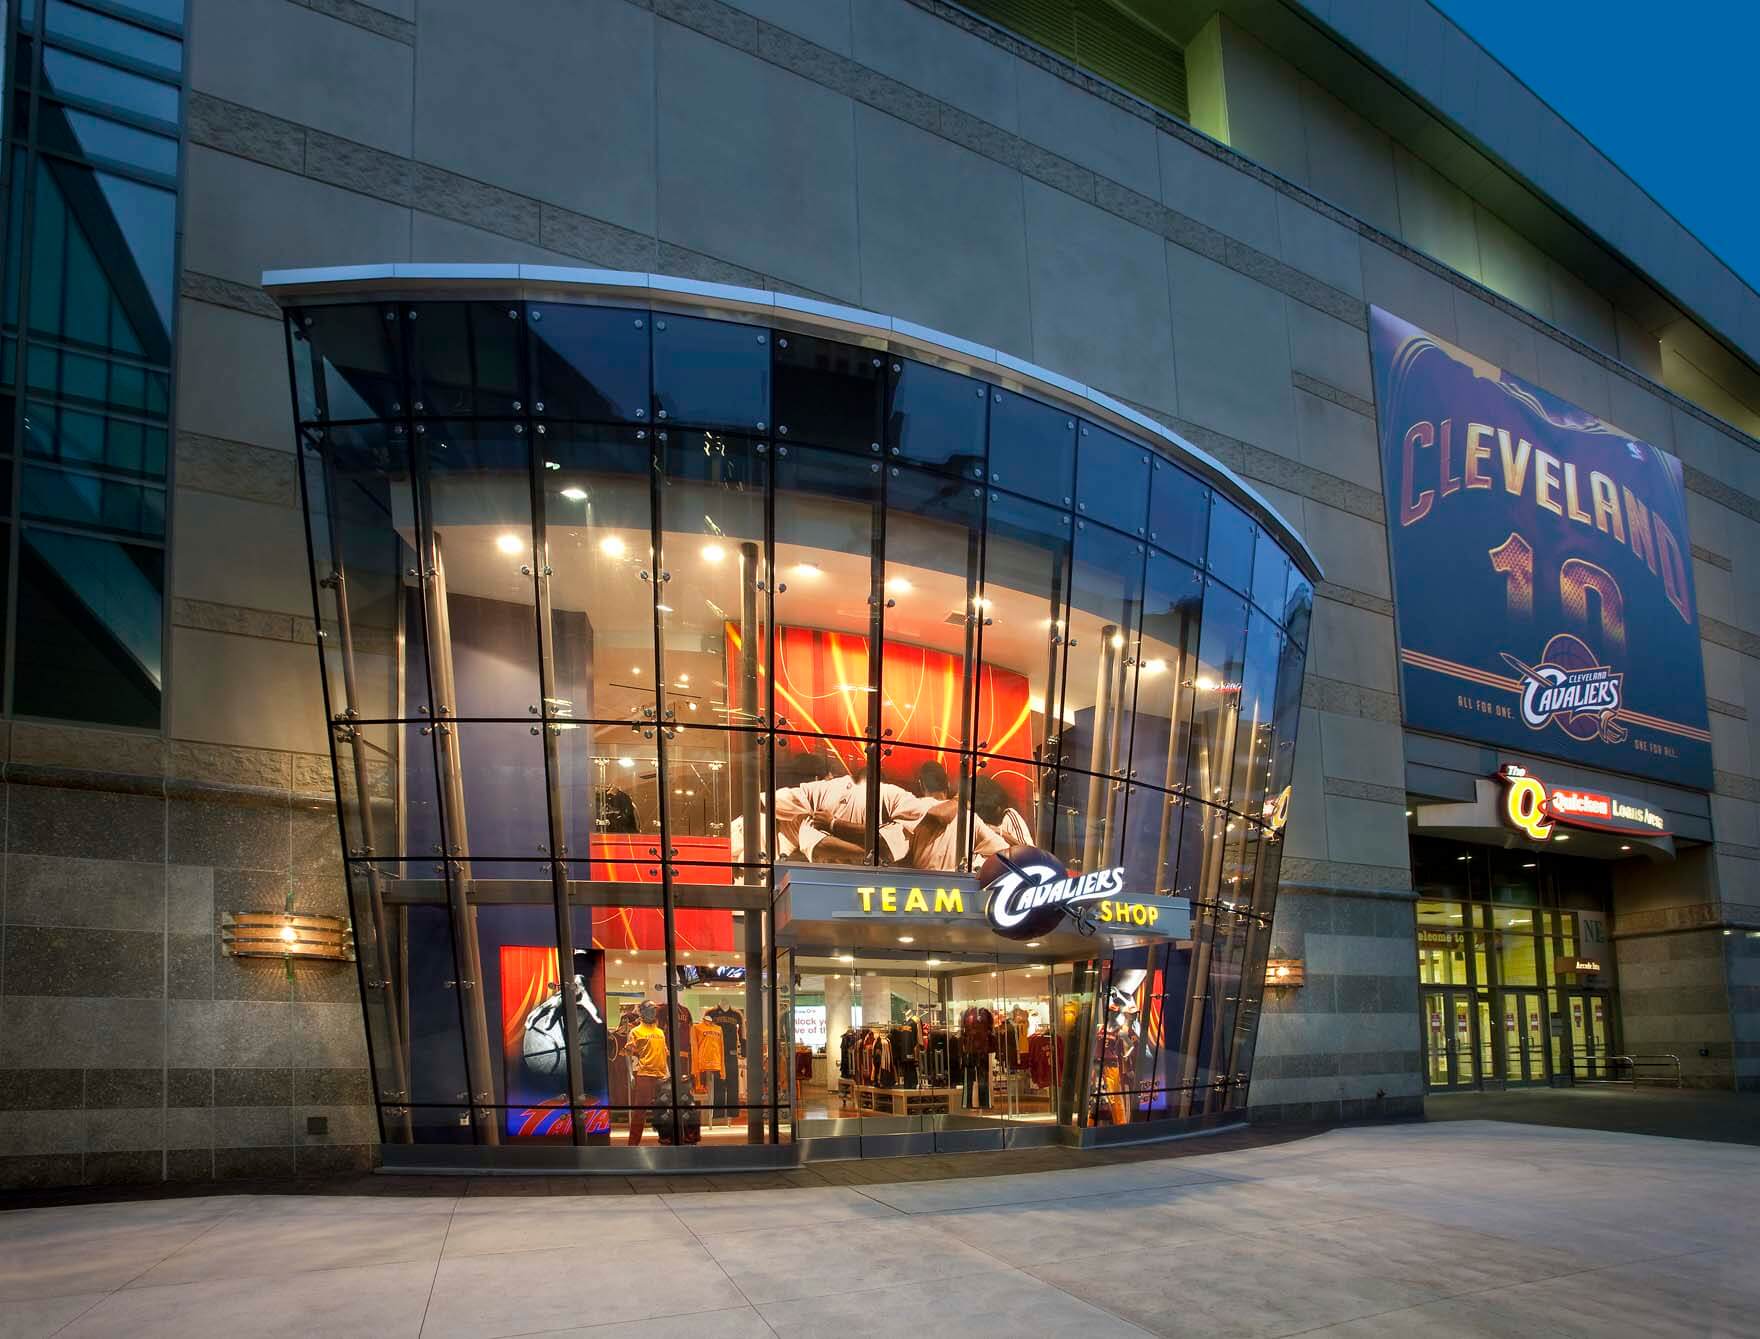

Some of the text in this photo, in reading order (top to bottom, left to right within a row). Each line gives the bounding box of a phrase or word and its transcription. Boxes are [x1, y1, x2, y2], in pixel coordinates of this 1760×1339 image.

[1400, 419, 1692, 624] CLEVELAND
[1488, 532, 1628, 650] 10
[1568, 671, 1608, 684] CLEVELAND
[1458, 696, 1516, 720] ALL FOR ONE.
[1523, 667, 1620, 725] CAVALIERS
[1634, 740, 1647, 752] ONE
[1507, 765, 1526, 777] The
[1508, 776, 1553, 840] Q
[1553, 791, 1609, 815] Quicken
[857, 887, 964, 913] TEAM
[985, 865, 1125, 927] CAVALIERS
[1100, 901, 1159, 927] SHOP
[1417, 930, 1464, 943] elcome to
